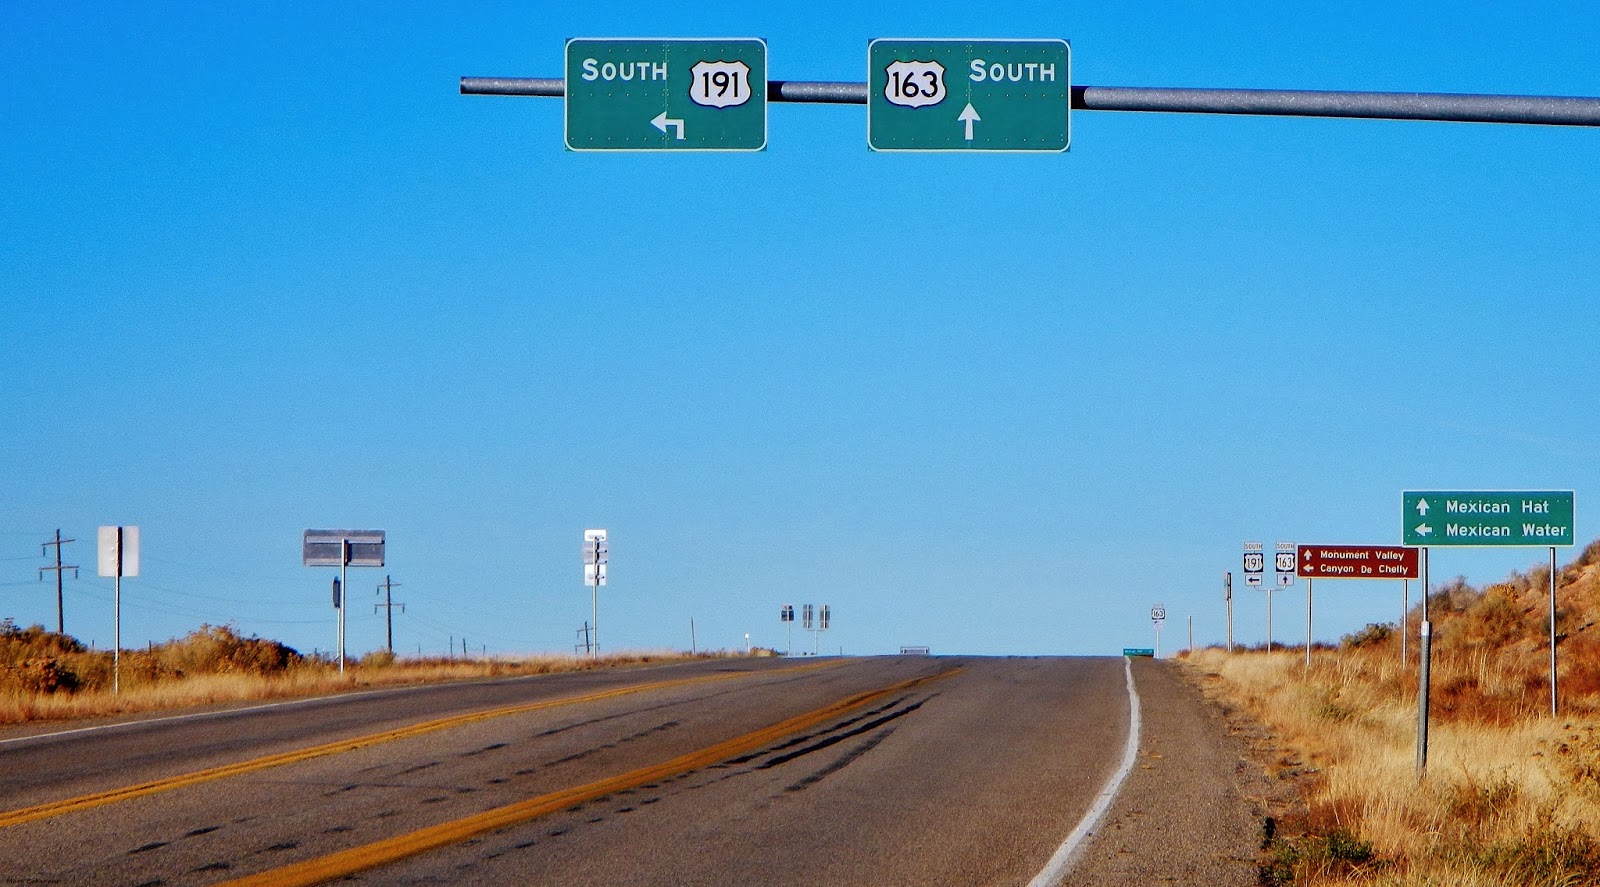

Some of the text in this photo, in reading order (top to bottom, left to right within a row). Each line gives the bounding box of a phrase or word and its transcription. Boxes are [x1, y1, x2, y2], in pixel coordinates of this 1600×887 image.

[581, 57, 668, 81] SOUTH
[969, 58, 1056, 82] SOUTH
[702, 71, 738, 98] 191
[892, 71, 938, 98] 163
[1446, 500, 1549, 513] Mexican Hat
[1446, 523, 1567, 537] Mexican Water
[1320, 550, 1405, 561] Monument Valley
[1247, 558, 1260, 569] 191
[1279, 557, 1292, 568] 163
[1320, 563, 1409, 575] Canyon De Chelly
